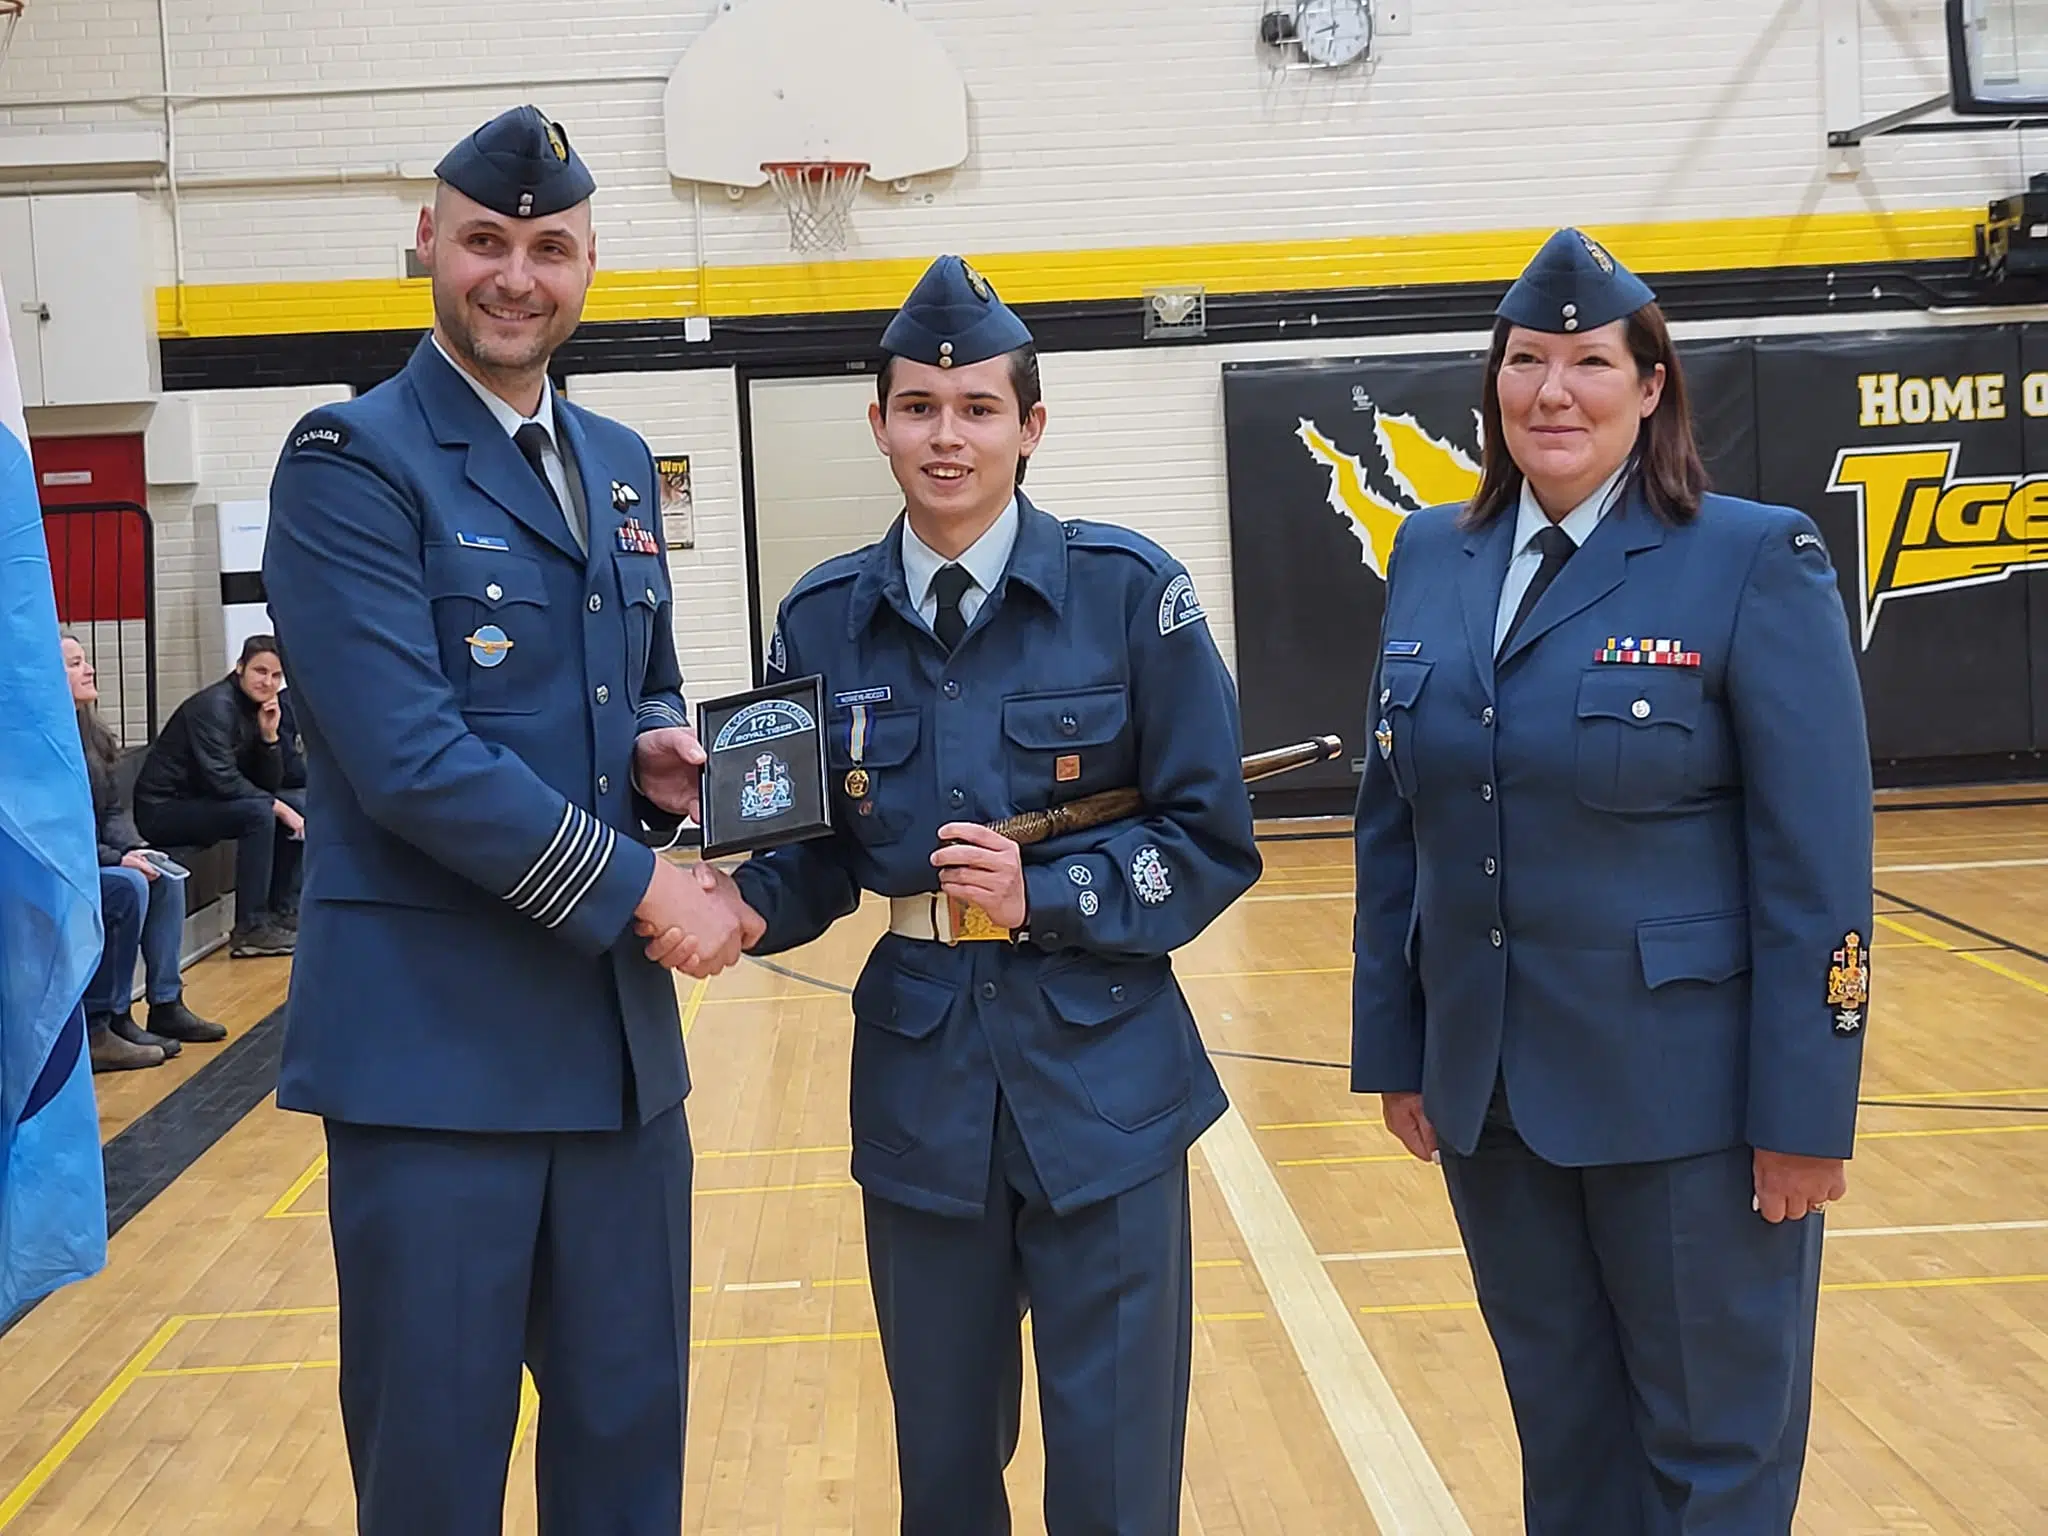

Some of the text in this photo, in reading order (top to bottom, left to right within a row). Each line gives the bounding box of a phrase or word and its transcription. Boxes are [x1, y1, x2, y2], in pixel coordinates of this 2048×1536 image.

[1857, 372, 2006, 426] HOME
[296, 429, 340, 447] CANADA
[749, 713, 777, 732] 173
[735, 723, 793, 742] ROYAL TIGER
